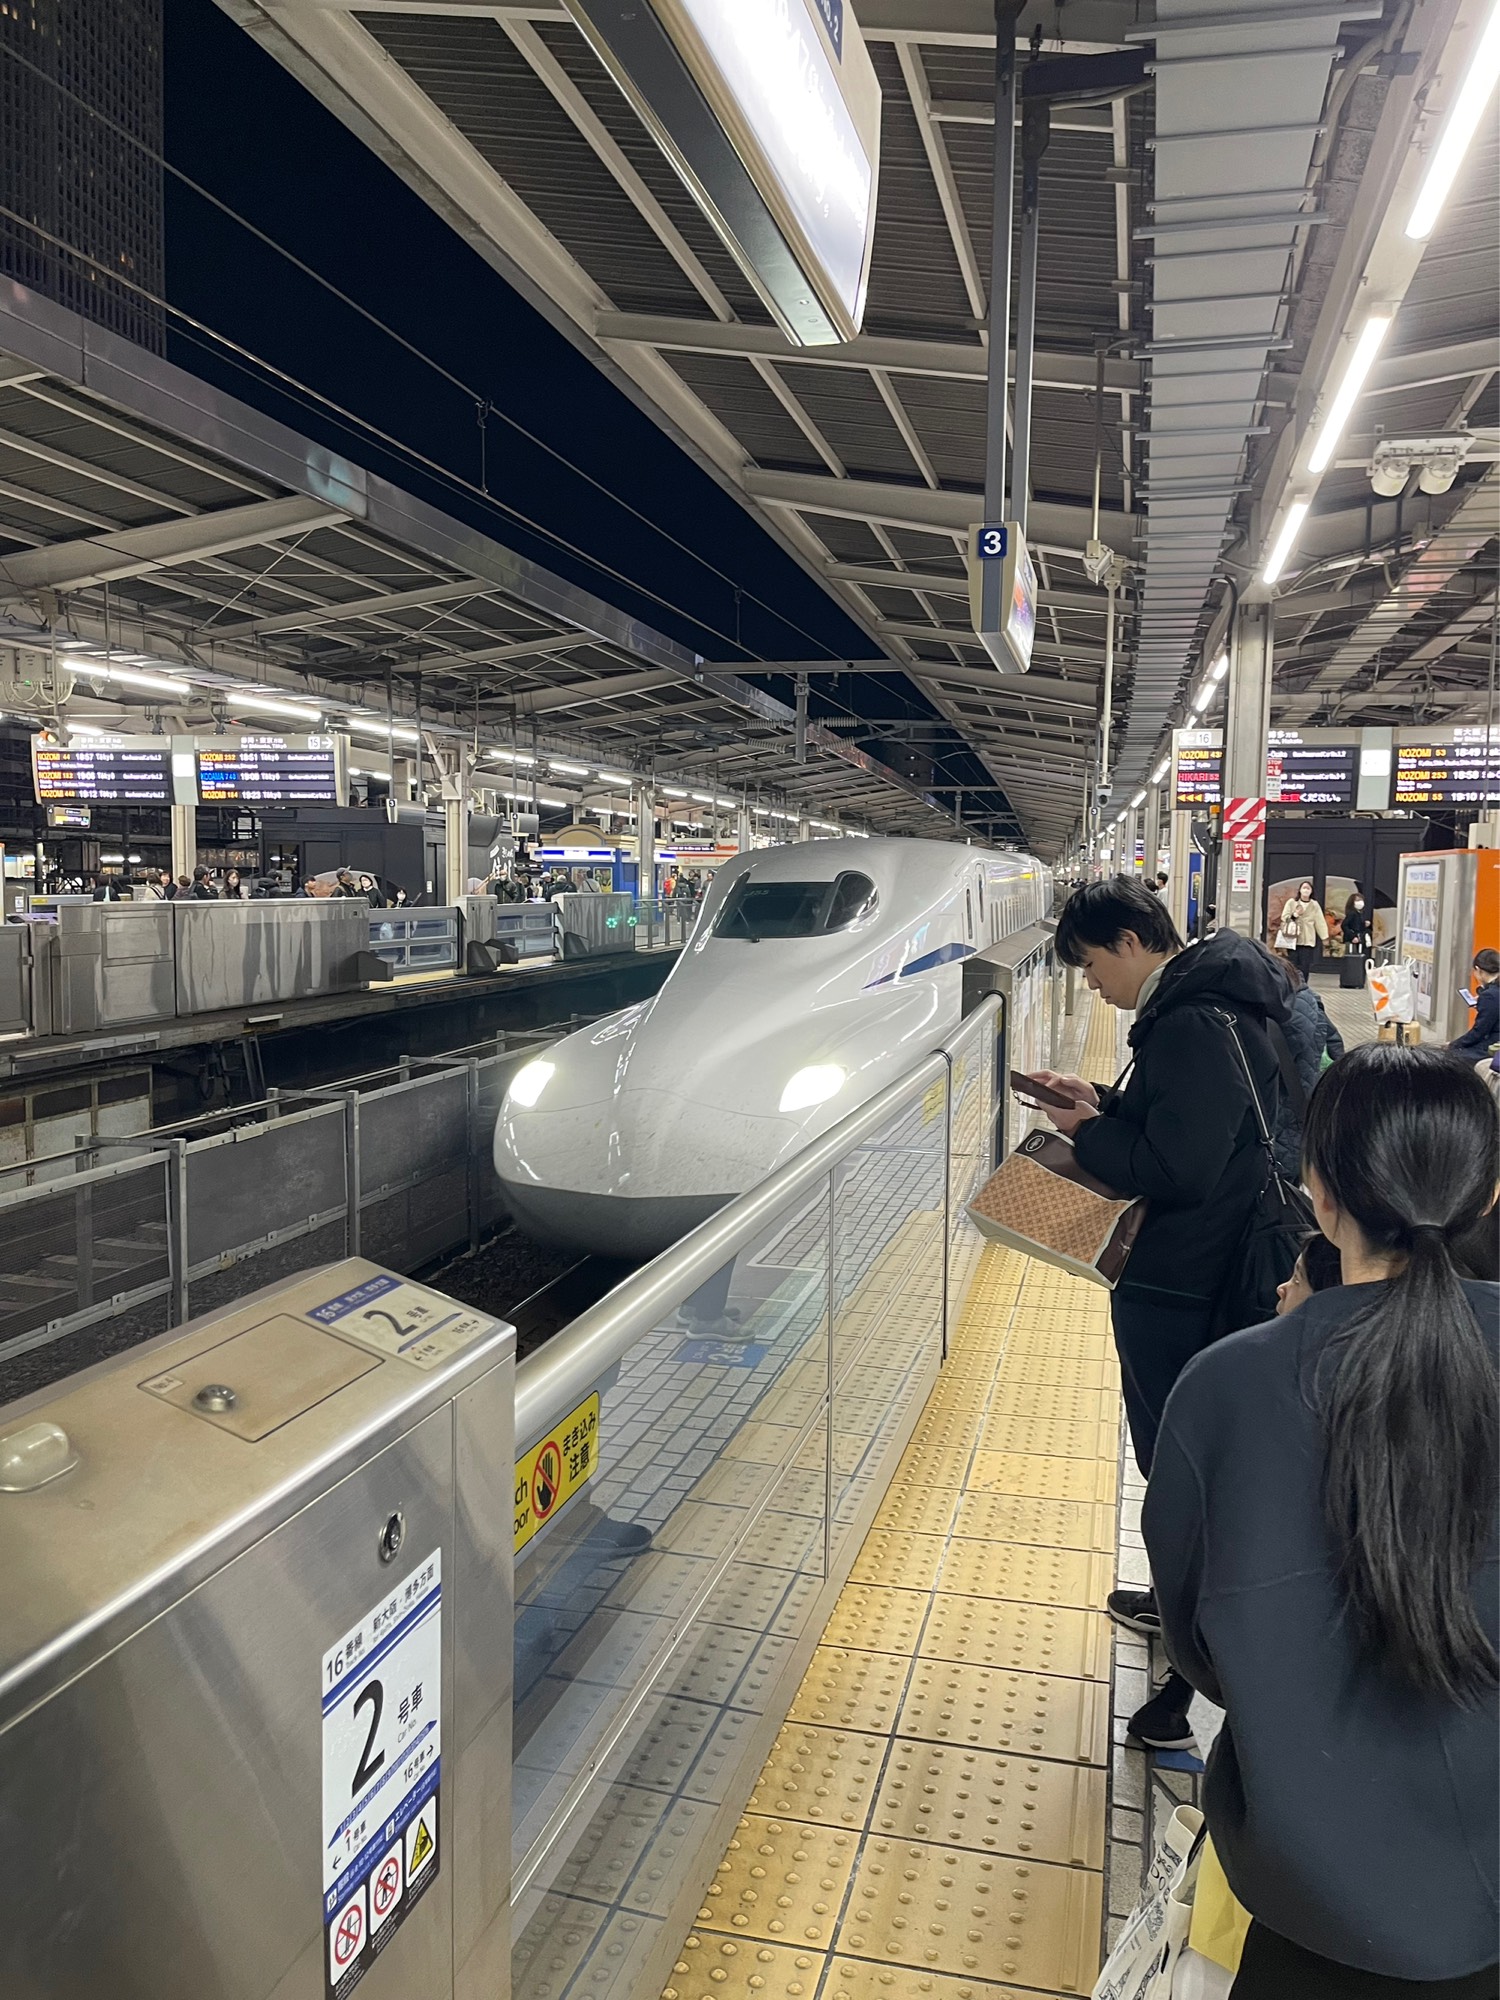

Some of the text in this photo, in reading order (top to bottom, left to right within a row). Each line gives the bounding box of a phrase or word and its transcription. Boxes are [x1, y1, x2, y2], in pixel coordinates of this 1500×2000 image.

[983, 531, 1002, 555] 3
[309, 738, 319, 747] 15
[1199, 733, 1210, 743] 16
[37, 753, 60, 761] NOZOMI
[1179, 751, 1209, 759] NOZOMI
[1399, 748, 1432, 758] NOZOMI
[200, 754, 224, 762] NOZOMI
[38, 772, 62, 780] NOZOMI
[1178, 773, 1209, 781] HIKARI
[1397, 771, 1430, 780] NOZOMI
[1431, 771, 1448, 780] 253
[40, 790, 64, 799] NOZOMI
[202, 790, 227, 799] NOZOMI
[1395, 792, 1429, 802] NOZOMI
[362, 1310, 418, 1337] 2
[562, 1411, 597, 1457] まき込み
[569, 1441, 590, 1483] 注意
[514, 1507, 530, 1535] oor
[351, 1680, 385, 1799] 2
[397, 1682, 423, 1725] 号車
